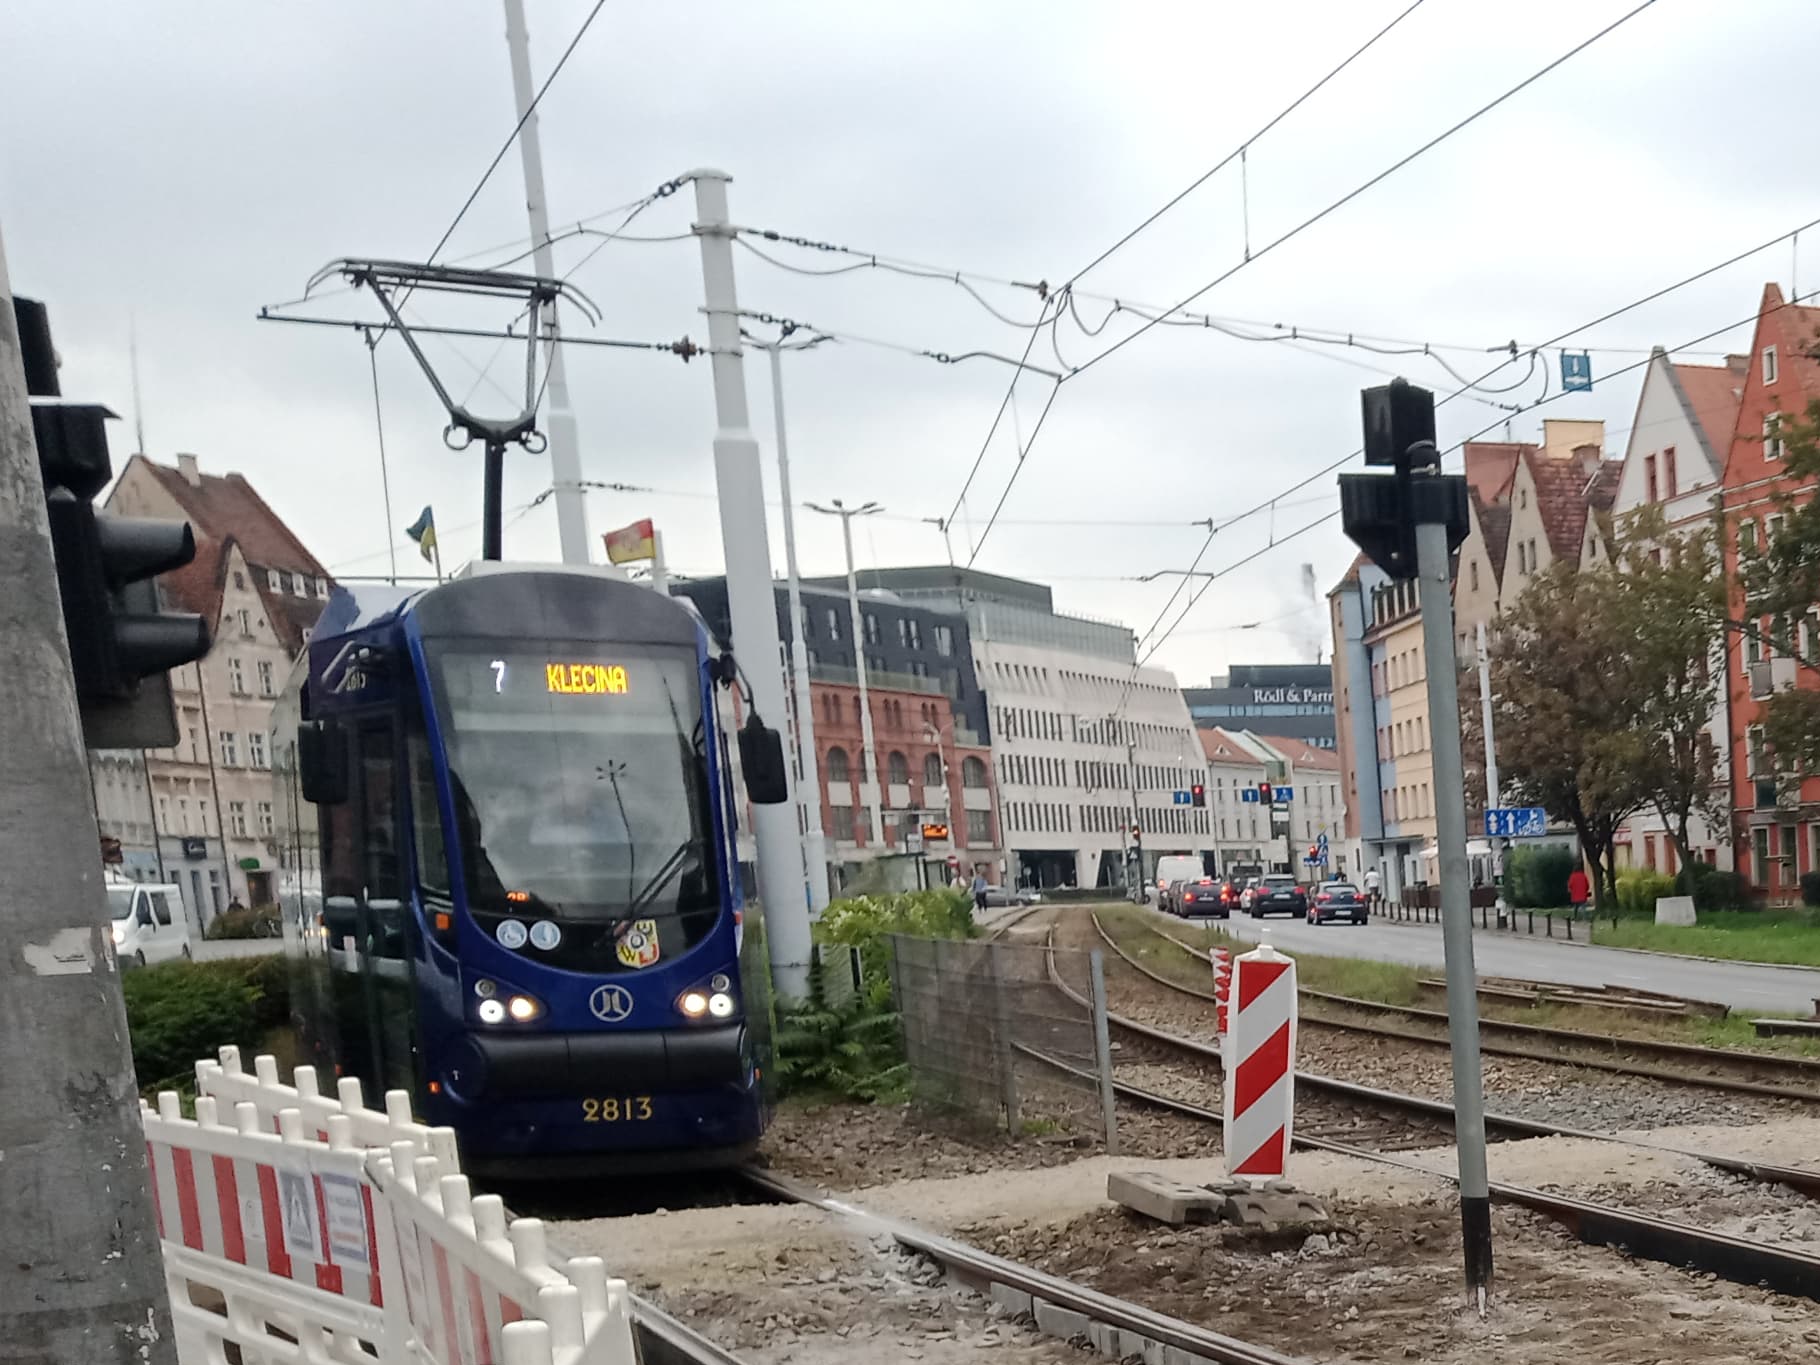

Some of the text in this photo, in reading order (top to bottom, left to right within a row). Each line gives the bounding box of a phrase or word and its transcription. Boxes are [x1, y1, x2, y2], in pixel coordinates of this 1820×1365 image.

[489, 659, 629, 695] 7 KLECINA
[1286, 689, 1301, 703] &
[582, 1096, 653, 1122] 2813
